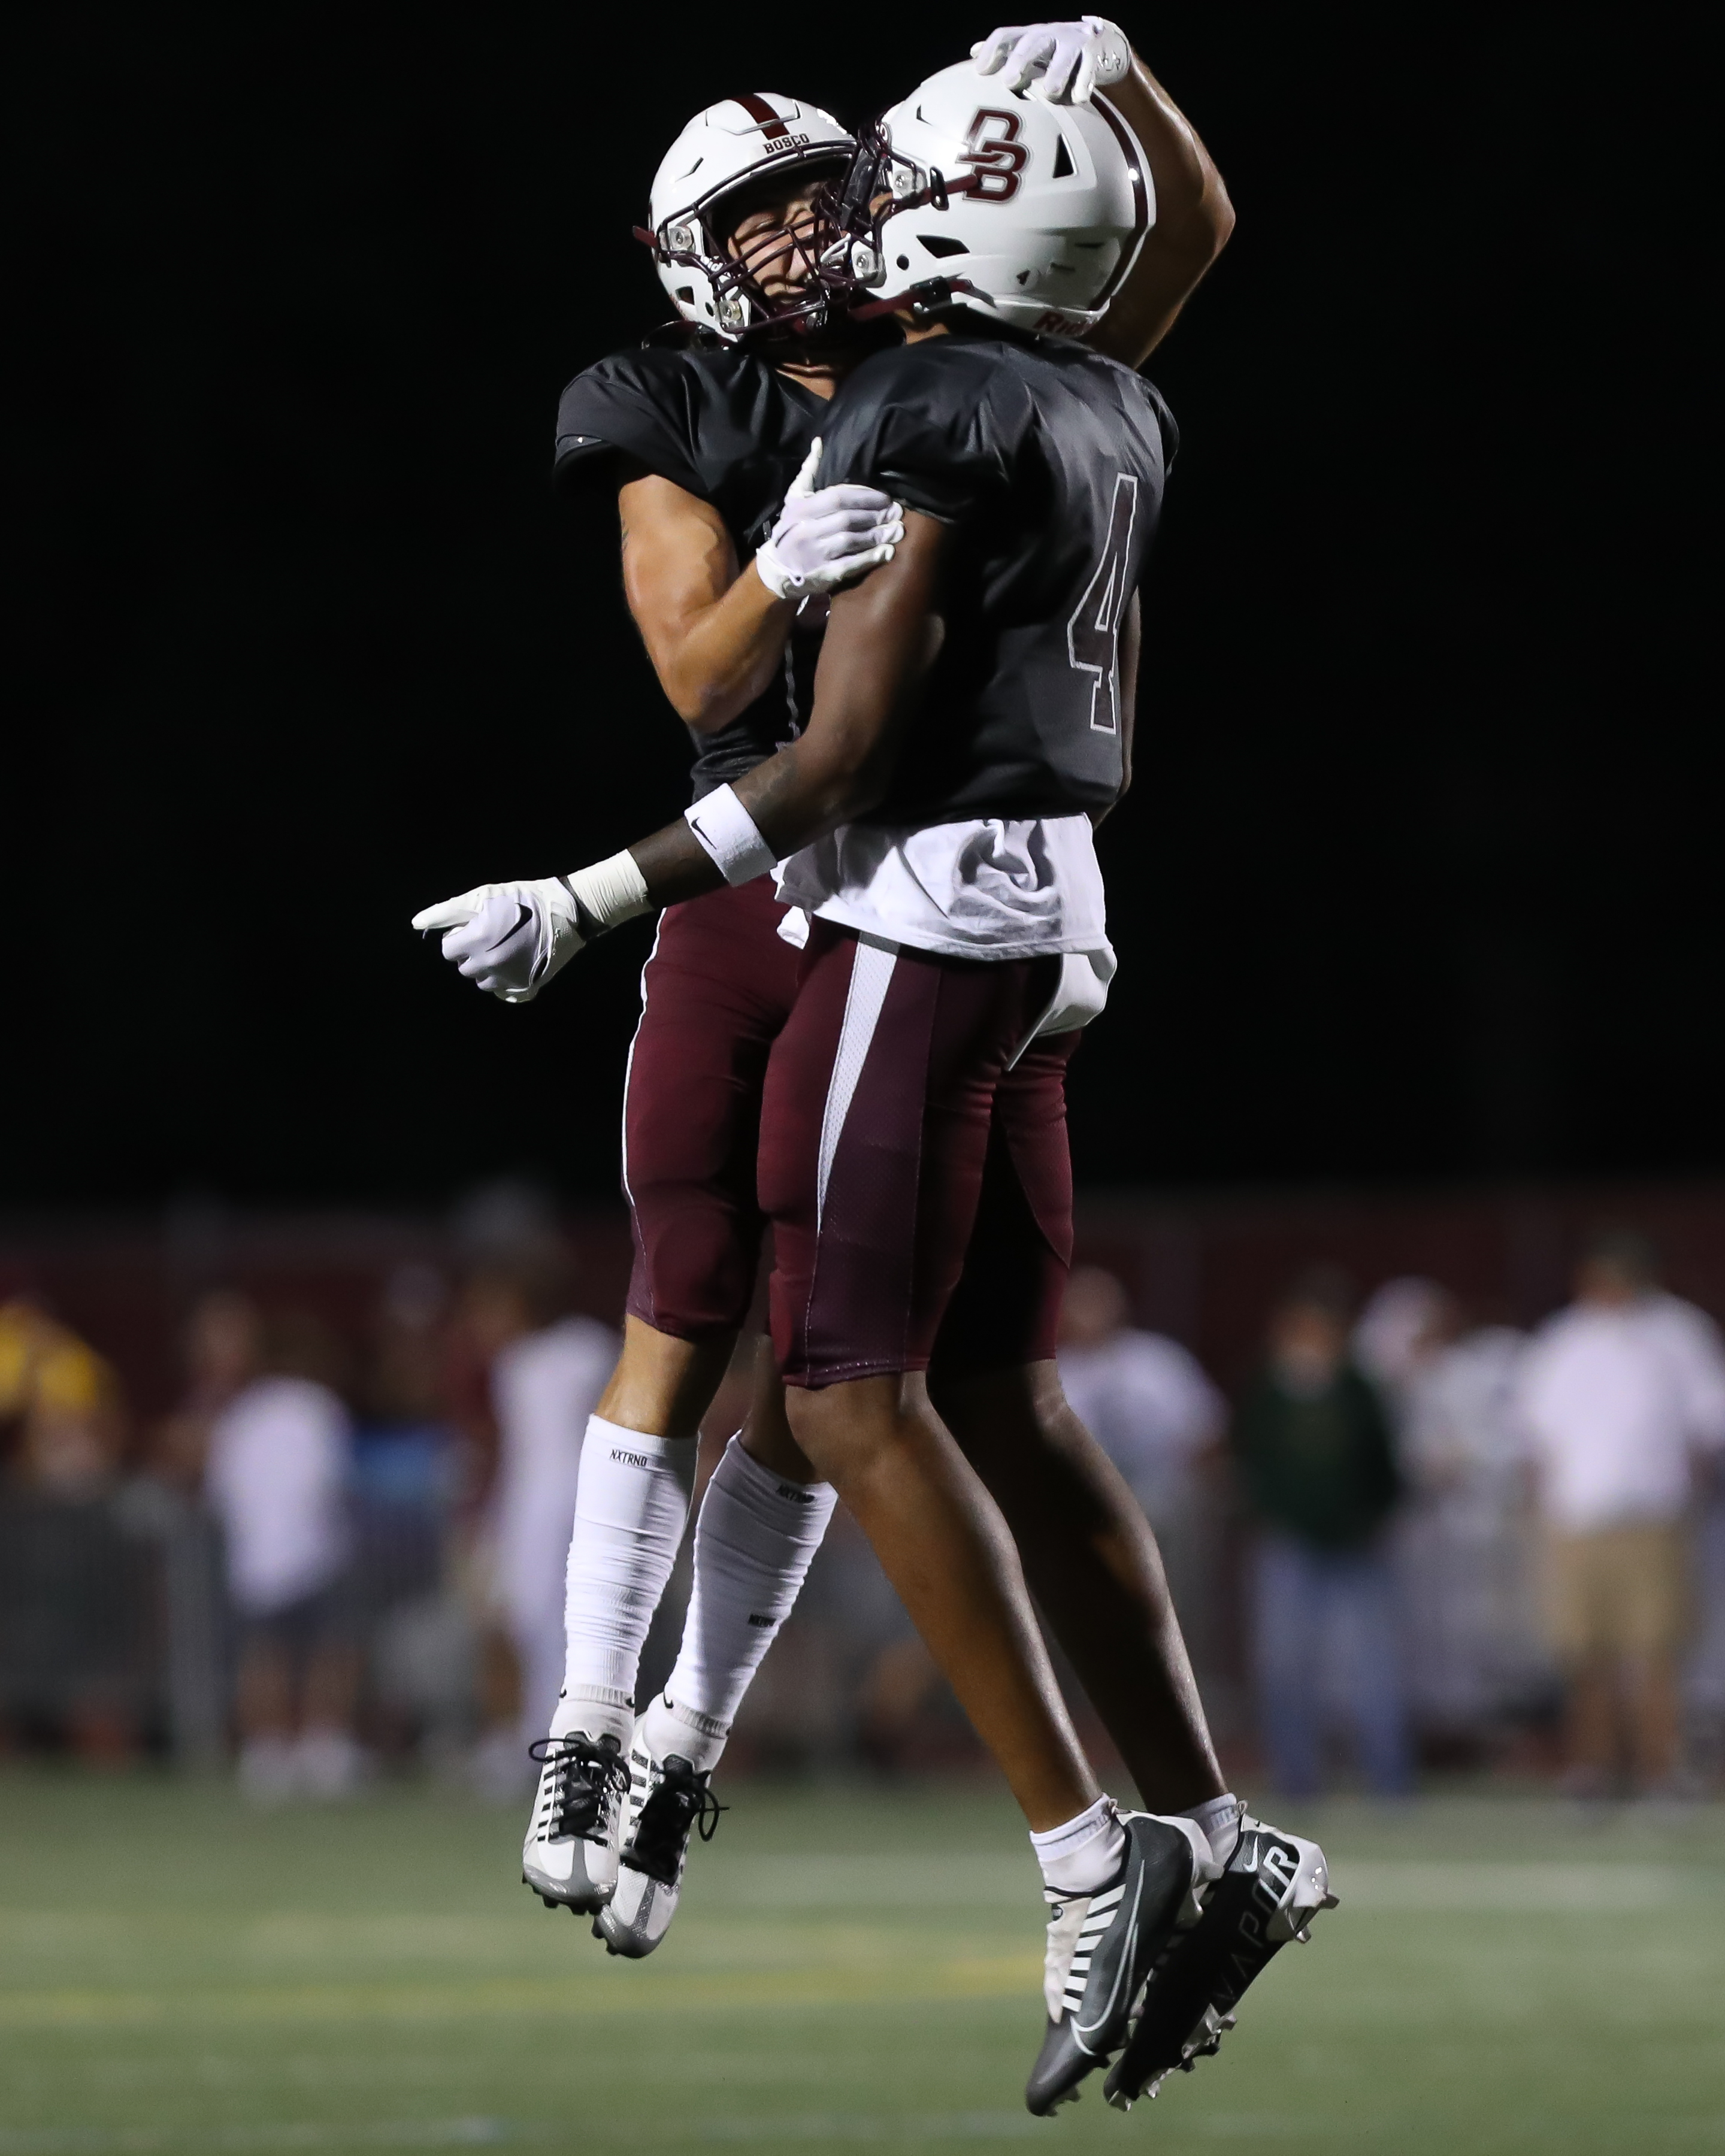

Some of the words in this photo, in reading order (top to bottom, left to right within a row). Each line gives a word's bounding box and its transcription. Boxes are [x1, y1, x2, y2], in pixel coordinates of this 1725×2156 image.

[762, 133, 810, 154] BOSCO
[955, 105, 1031, 204] DB
[1067, 471, 1138, 735] 4
[610, 1449, 648, 1467] NXTRND
[1212, 1846, 1299, 2003] VAPOR
